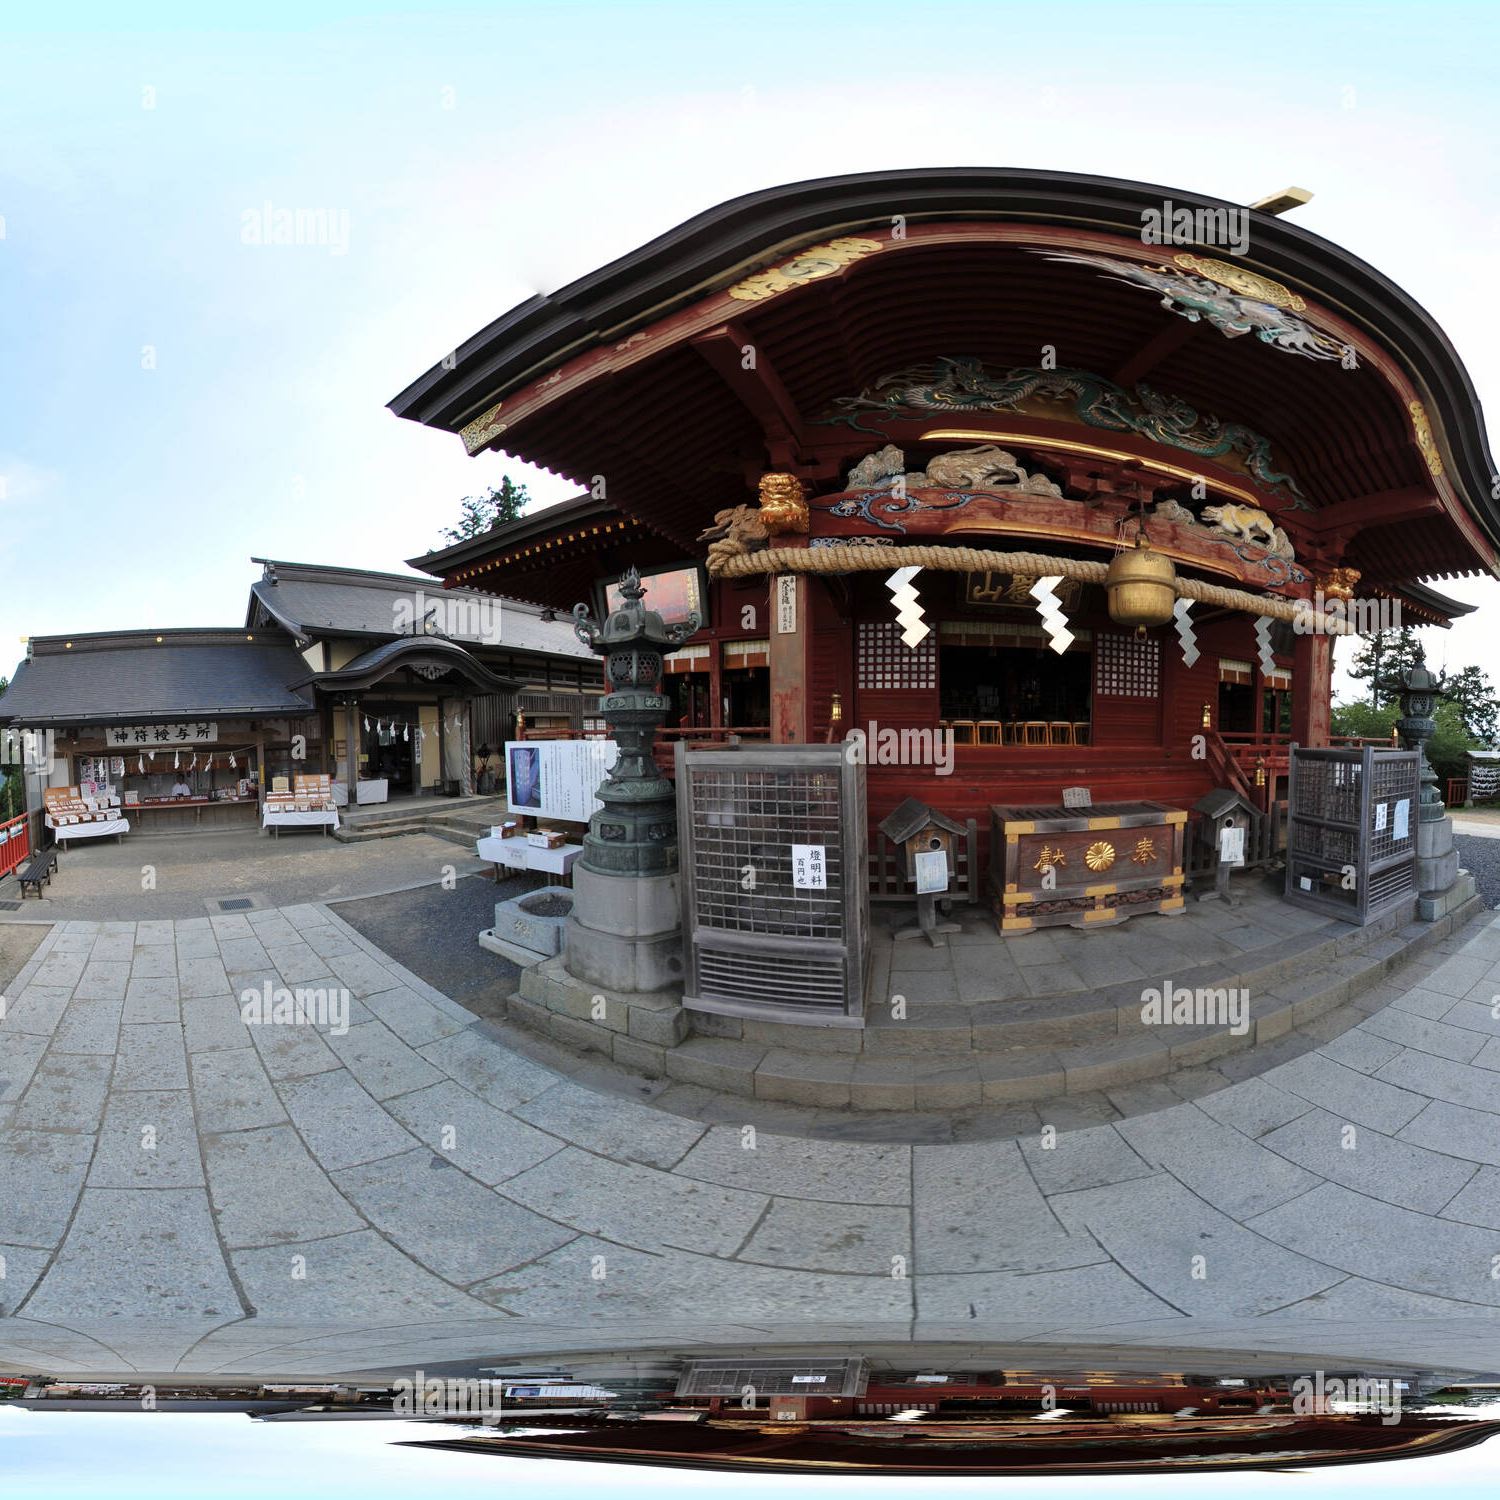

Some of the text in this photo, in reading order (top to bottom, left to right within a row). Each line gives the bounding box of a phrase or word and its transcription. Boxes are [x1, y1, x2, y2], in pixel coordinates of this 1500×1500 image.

[114, 726, 211, 743] 神符授与所
[809, 850, 822, 886] 燈明料
